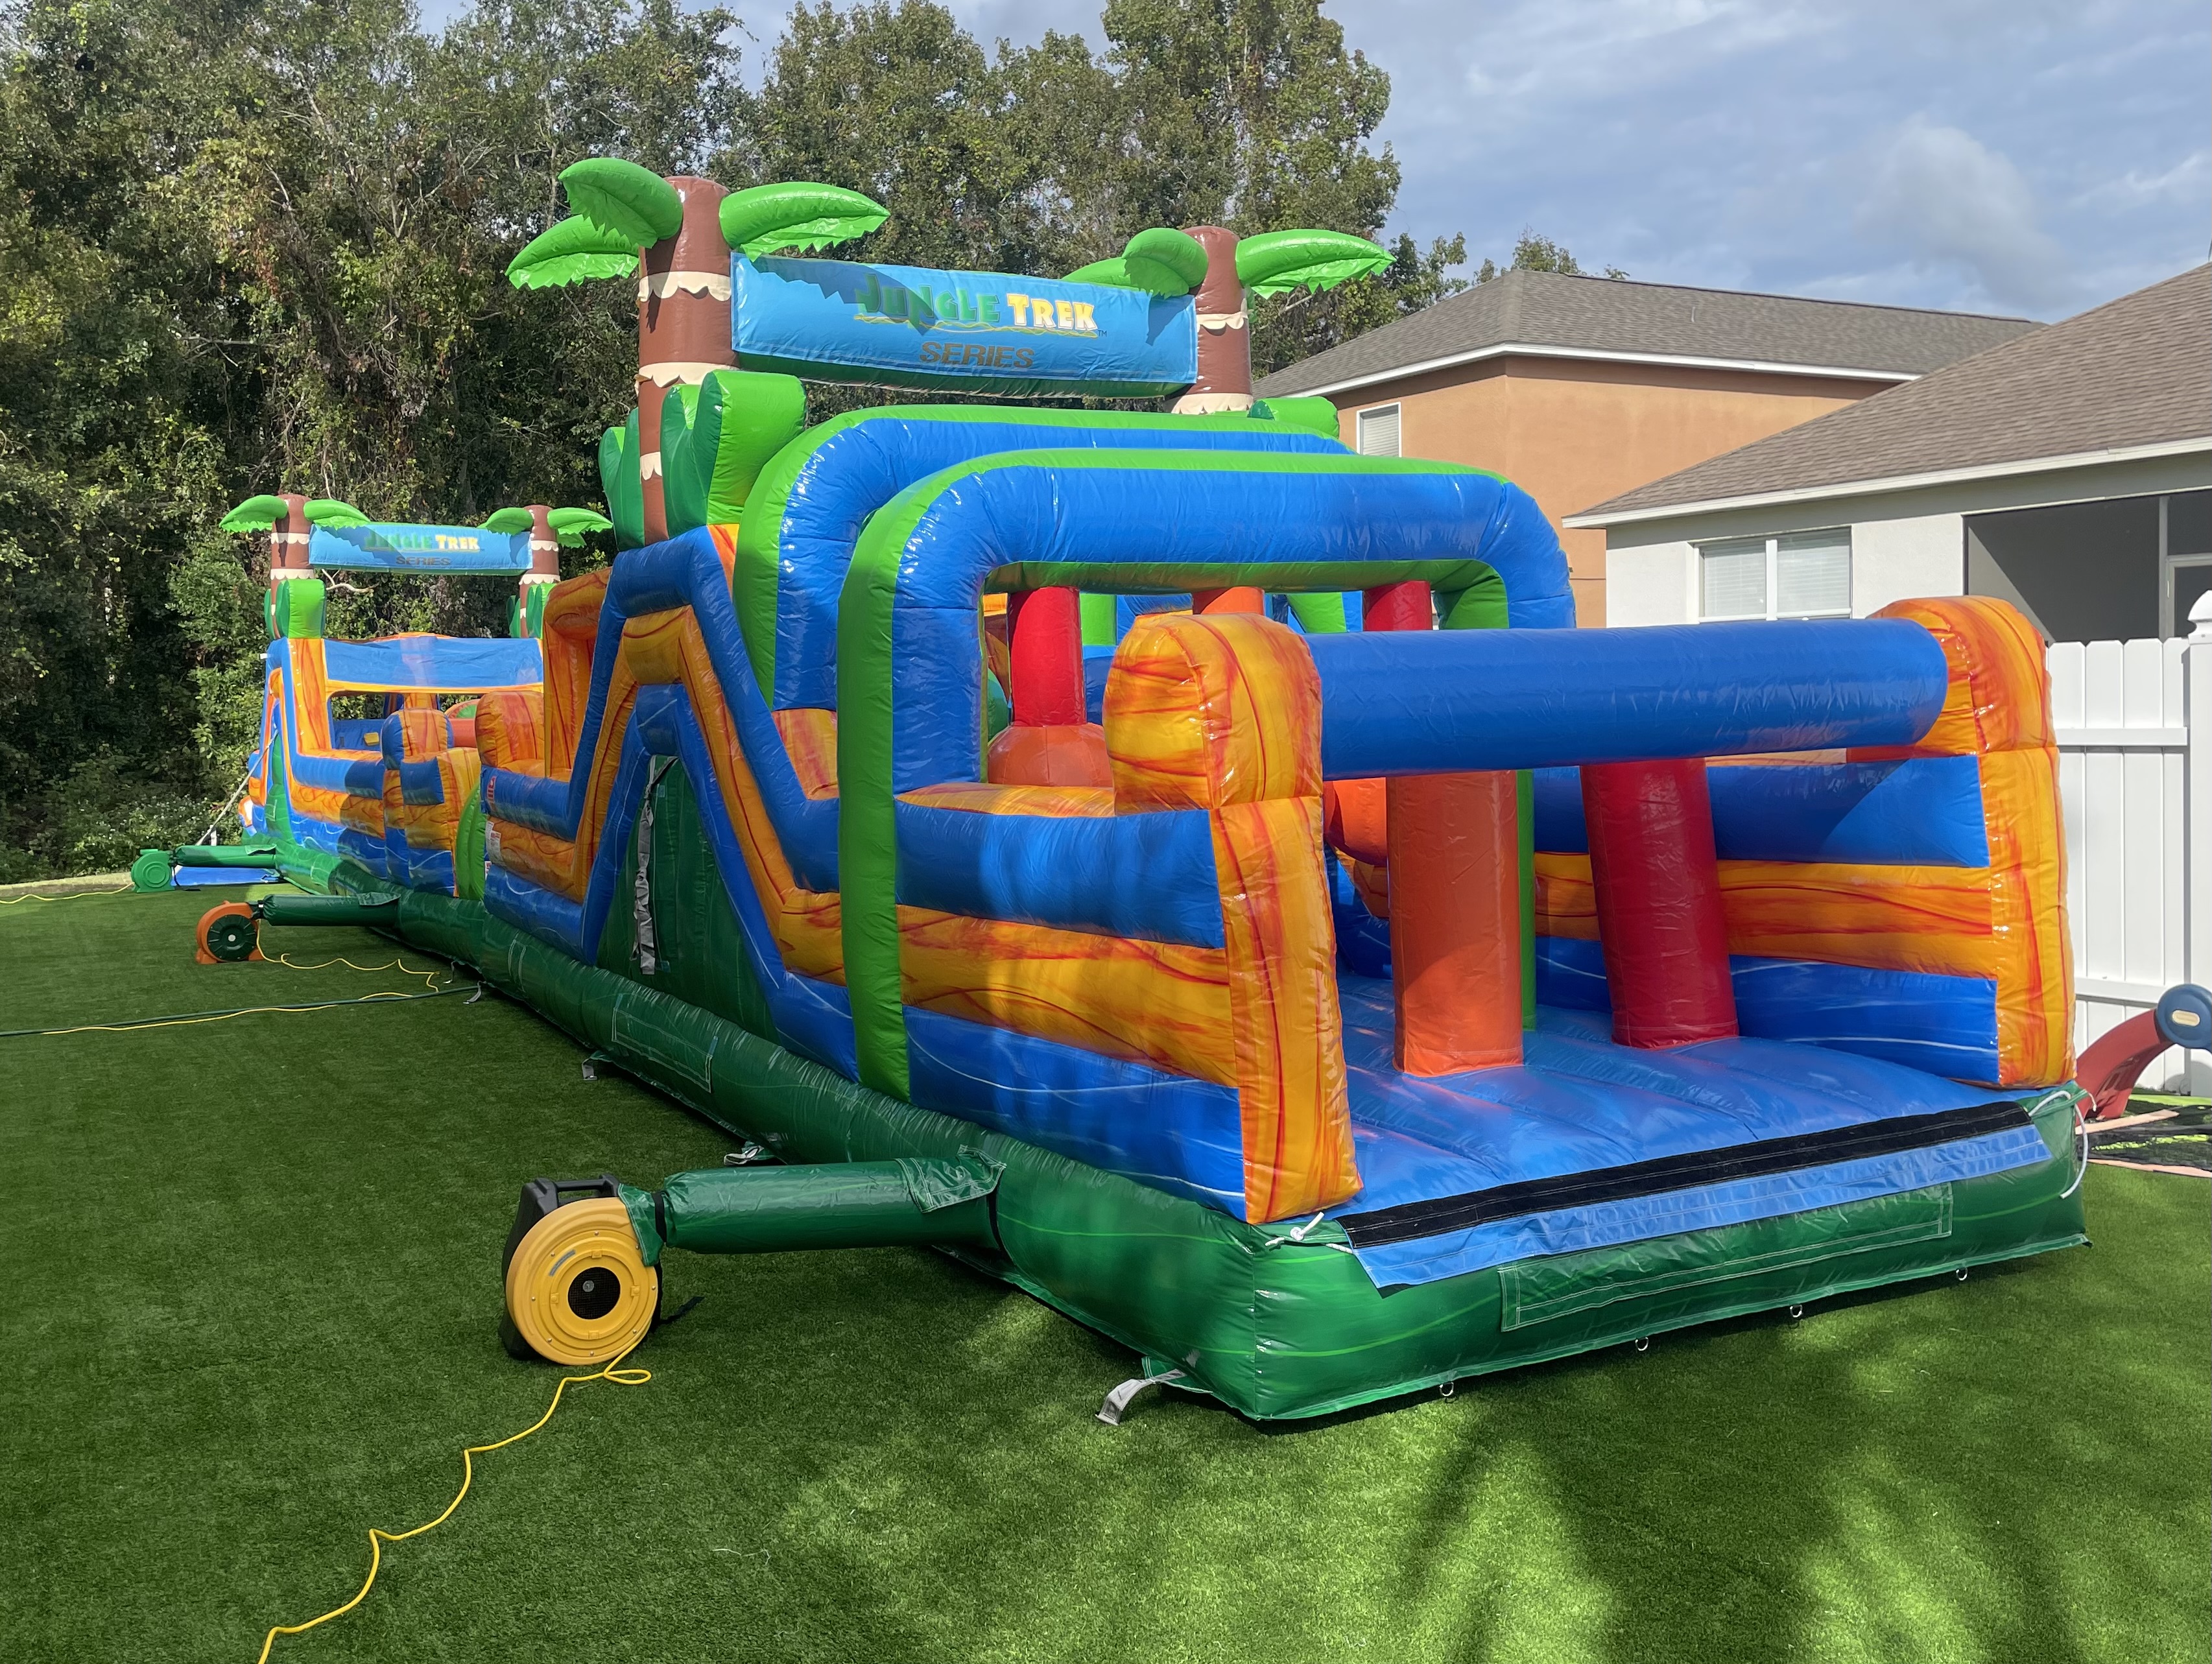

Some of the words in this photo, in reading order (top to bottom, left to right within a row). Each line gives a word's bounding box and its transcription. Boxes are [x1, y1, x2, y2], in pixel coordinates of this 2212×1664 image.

[855, 274, 1000, 327] JUNGLE
[1006, 293, 1098, 330] TREK
[920, 342, 1034, 368] SERIES
[436, 535, 479, 550] TREK
[396, 556, 451, 565] SERIES
